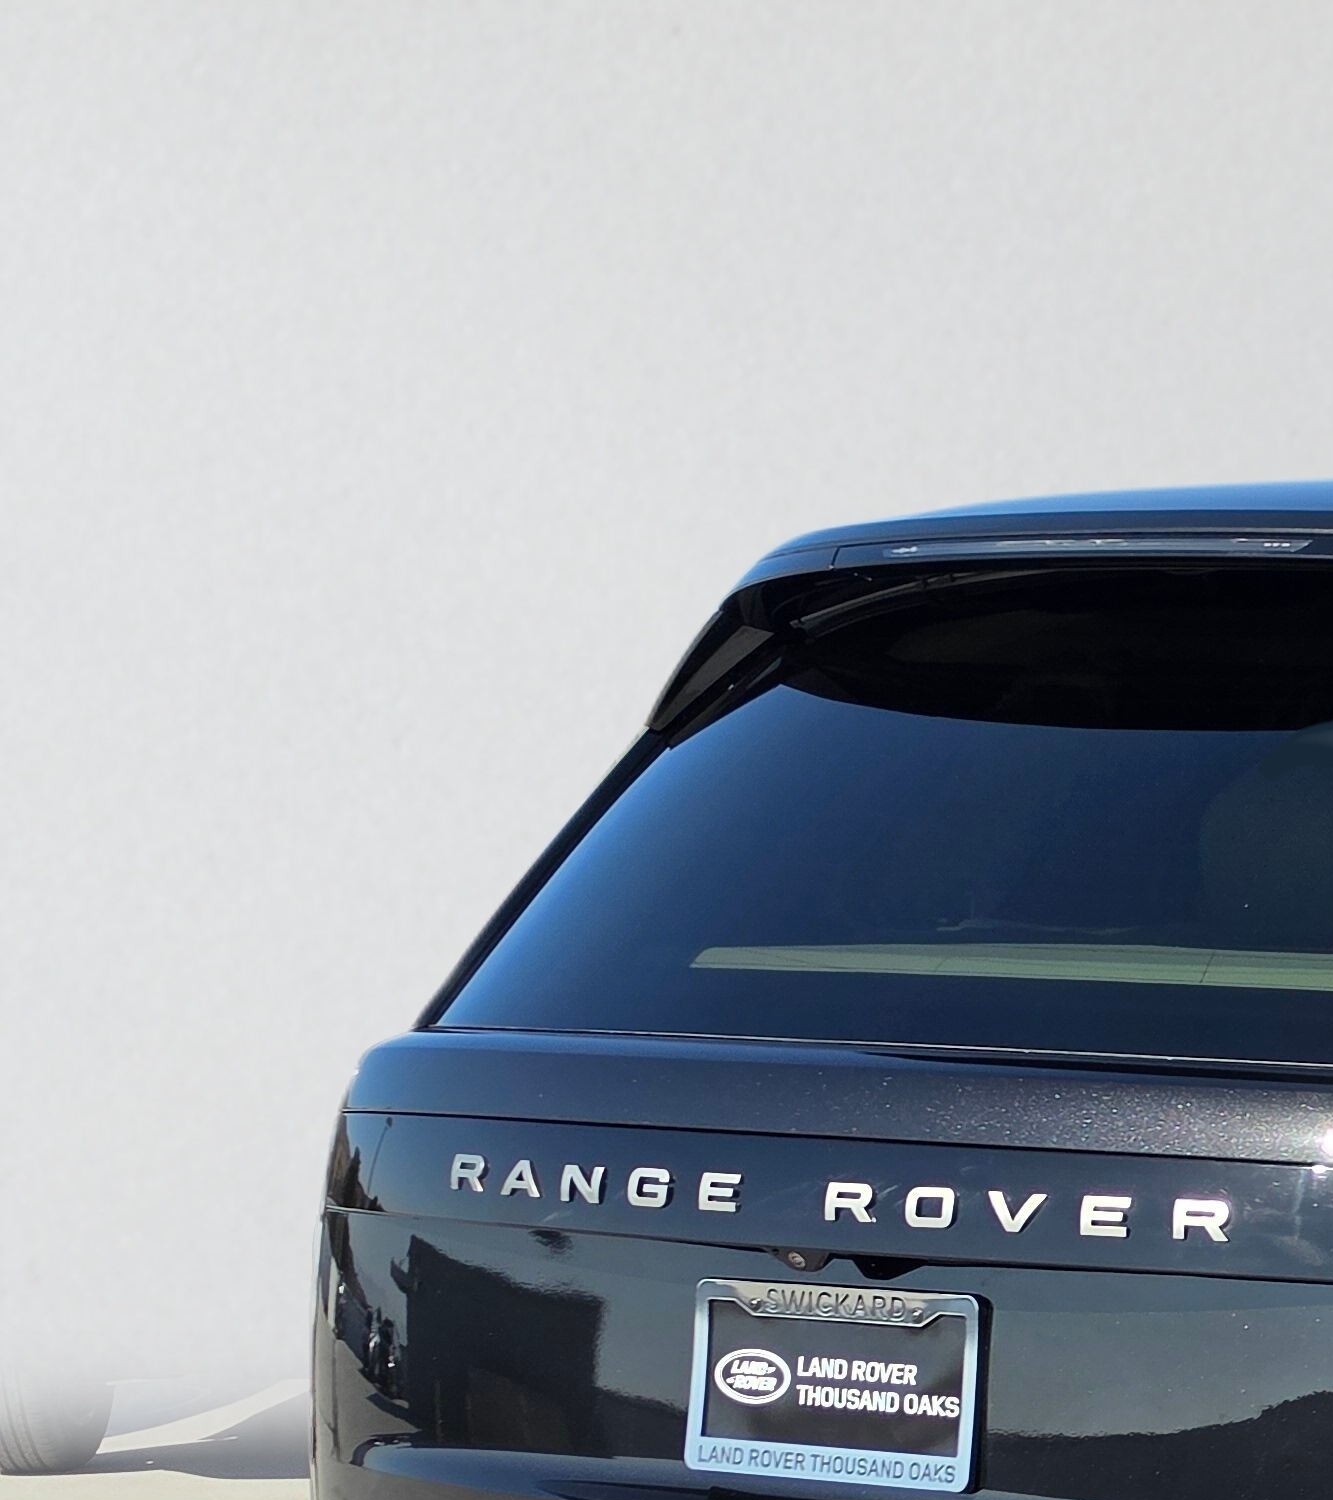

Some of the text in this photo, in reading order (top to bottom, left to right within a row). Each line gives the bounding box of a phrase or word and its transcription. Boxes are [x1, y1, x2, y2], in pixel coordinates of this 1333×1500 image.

[449, 1152, 1232, 1243] RANGE ROVER
[765, 1287, 909, 1322] SWICKARD
[730, 1359, 770, 1375] LAND
[732, 1376, 778, 1392] ROVER
[796, 1355, 918, 1386] LAND ROVER
[796, 1384, 961, 1418] THOUSAND OAKS
[698, 1445, 956, 1484] LAND ROVER THOUSAND OAKS
